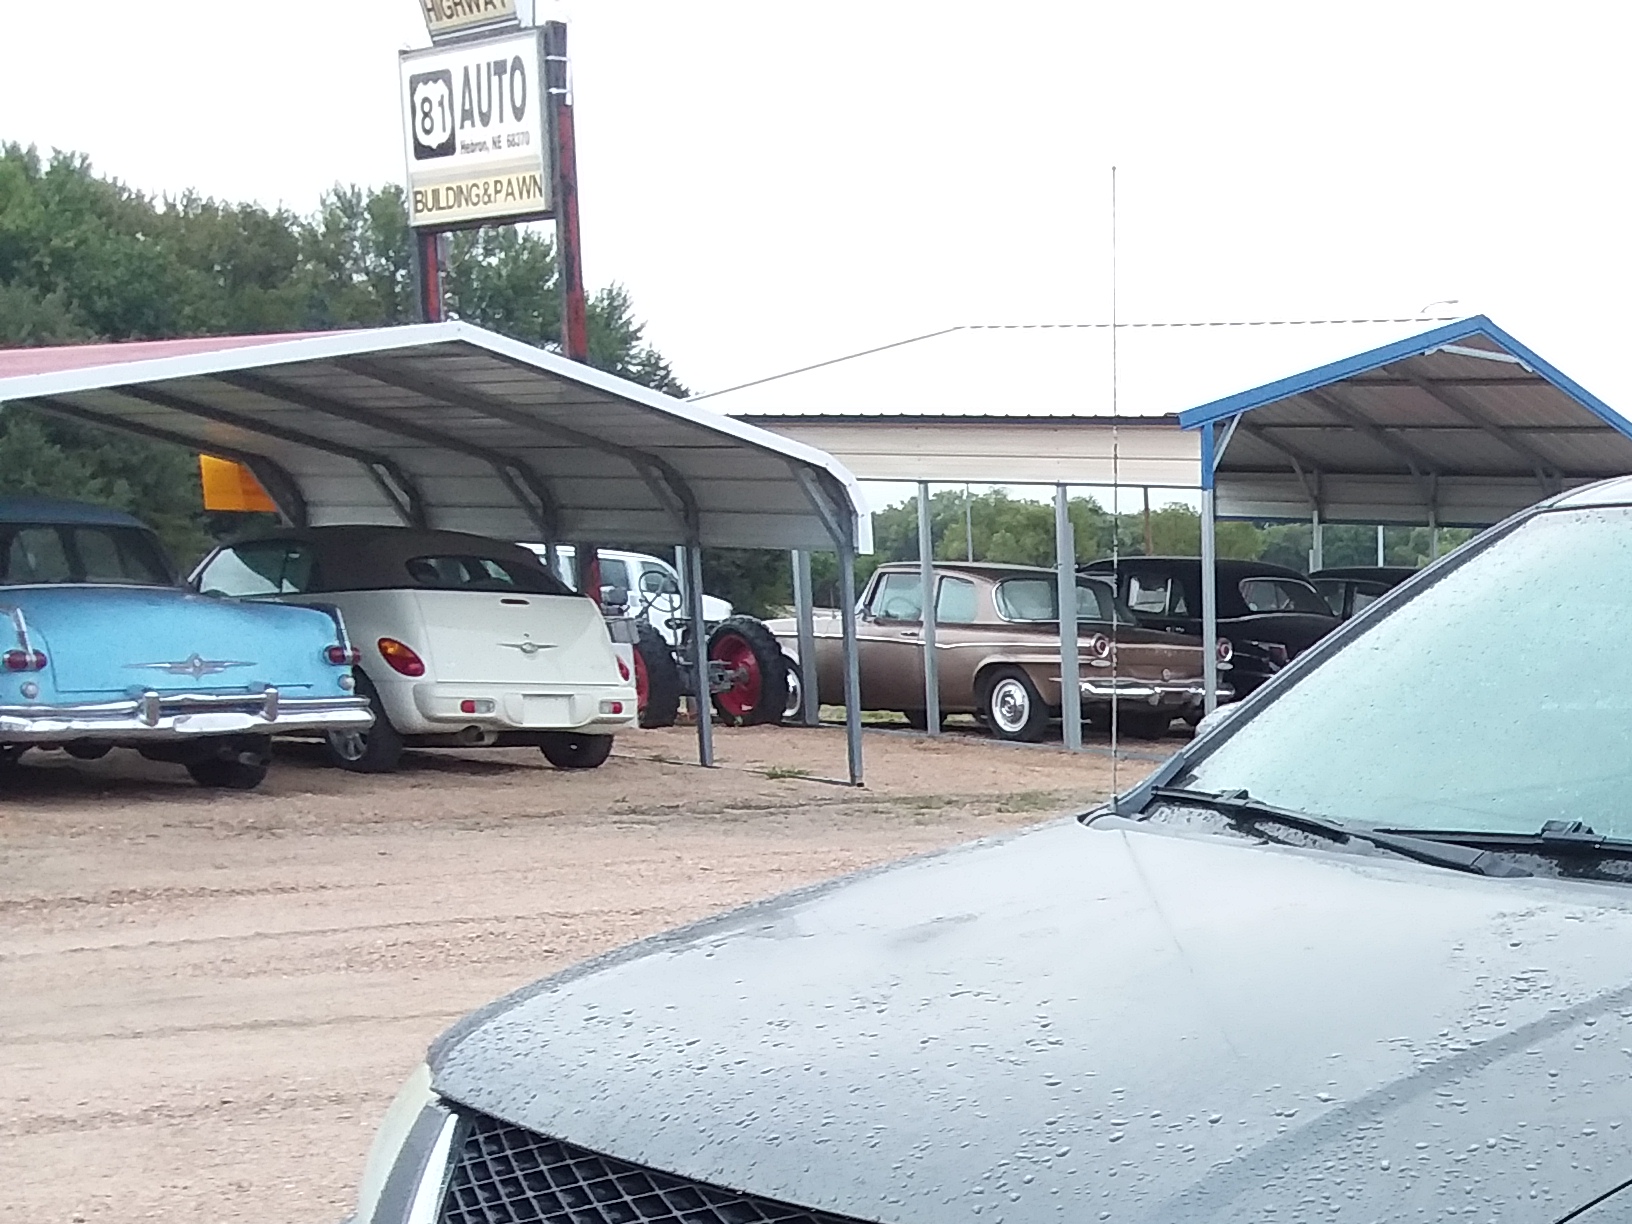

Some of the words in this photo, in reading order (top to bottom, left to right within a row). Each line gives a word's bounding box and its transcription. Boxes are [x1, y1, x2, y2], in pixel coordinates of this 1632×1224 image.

[459, 55, 527, 130] AUTO
[421, 95, 446, 135] 81
[491, 134, 502, 150] NE
